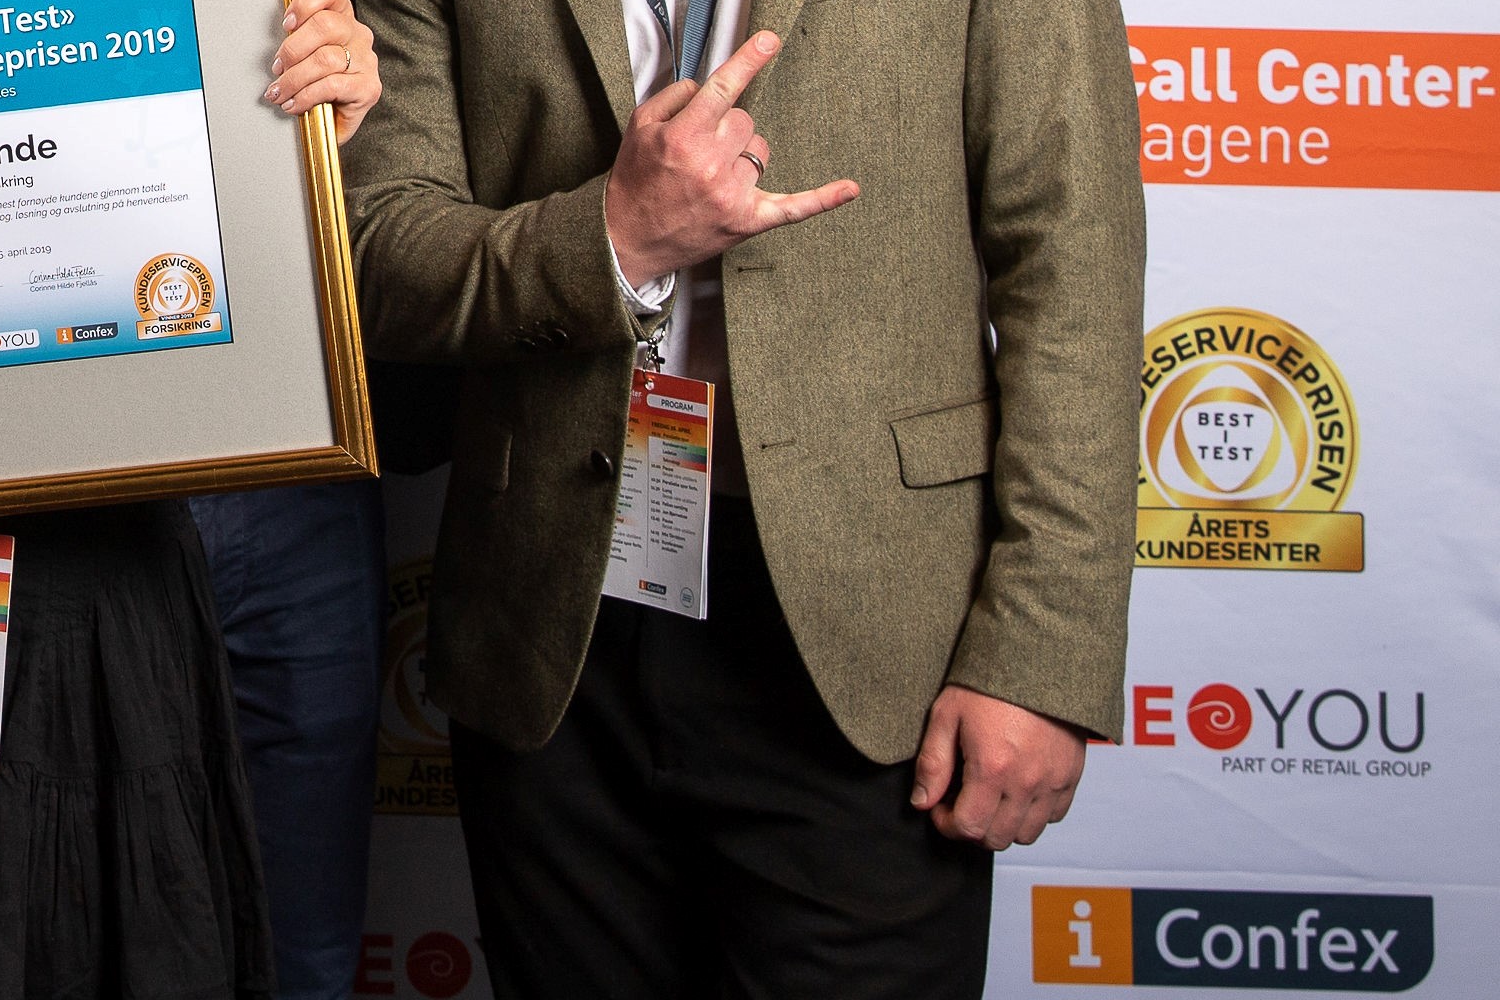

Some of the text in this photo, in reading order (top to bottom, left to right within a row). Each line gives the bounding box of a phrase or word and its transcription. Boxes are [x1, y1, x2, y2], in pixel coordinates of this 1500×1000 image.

[105, 25, 176, 59] 2019
[1257, 48, 1496, 109] Center-
[17, 194, 58, 209] fornøyde
[60, 191, 98, 202] kundene
[100, 187, 140, 200] gjennom
[142, 183, 166, 193] totalt
[15, 208, 48, 220] løsning
[50, 207, 62, 217] og
[64, 199, 110, 214] avslutning
[111, 198, 125, 210] på
[7, 246, 28, 258] april
[30, 245, 52, 255] 2019
[29, 283, 56, 293] Corinne
[138, 257, 211, 313] KUNDESERVICEPRISEN
[75, 325, 114, 339] Confex
[145, 320, 211, 335] FORSIKRING
[1, 332, 35, 348] YOU
[661, 399, 694, 412] PROGRAM
[1140, 325, 1345, 495] ESERVICEPRISEN
[1198, 412, 1254, 427] BEST
[1198, 446, 1254, 461] TEST
[1187, 513, 1269, 538] ÅRETS
[1255, 688, 1425, 754] YOU
[1221, 757, 1431, 777] PART OF RETAIL GROUP
[1156, 908, 1399, 973] Confex
